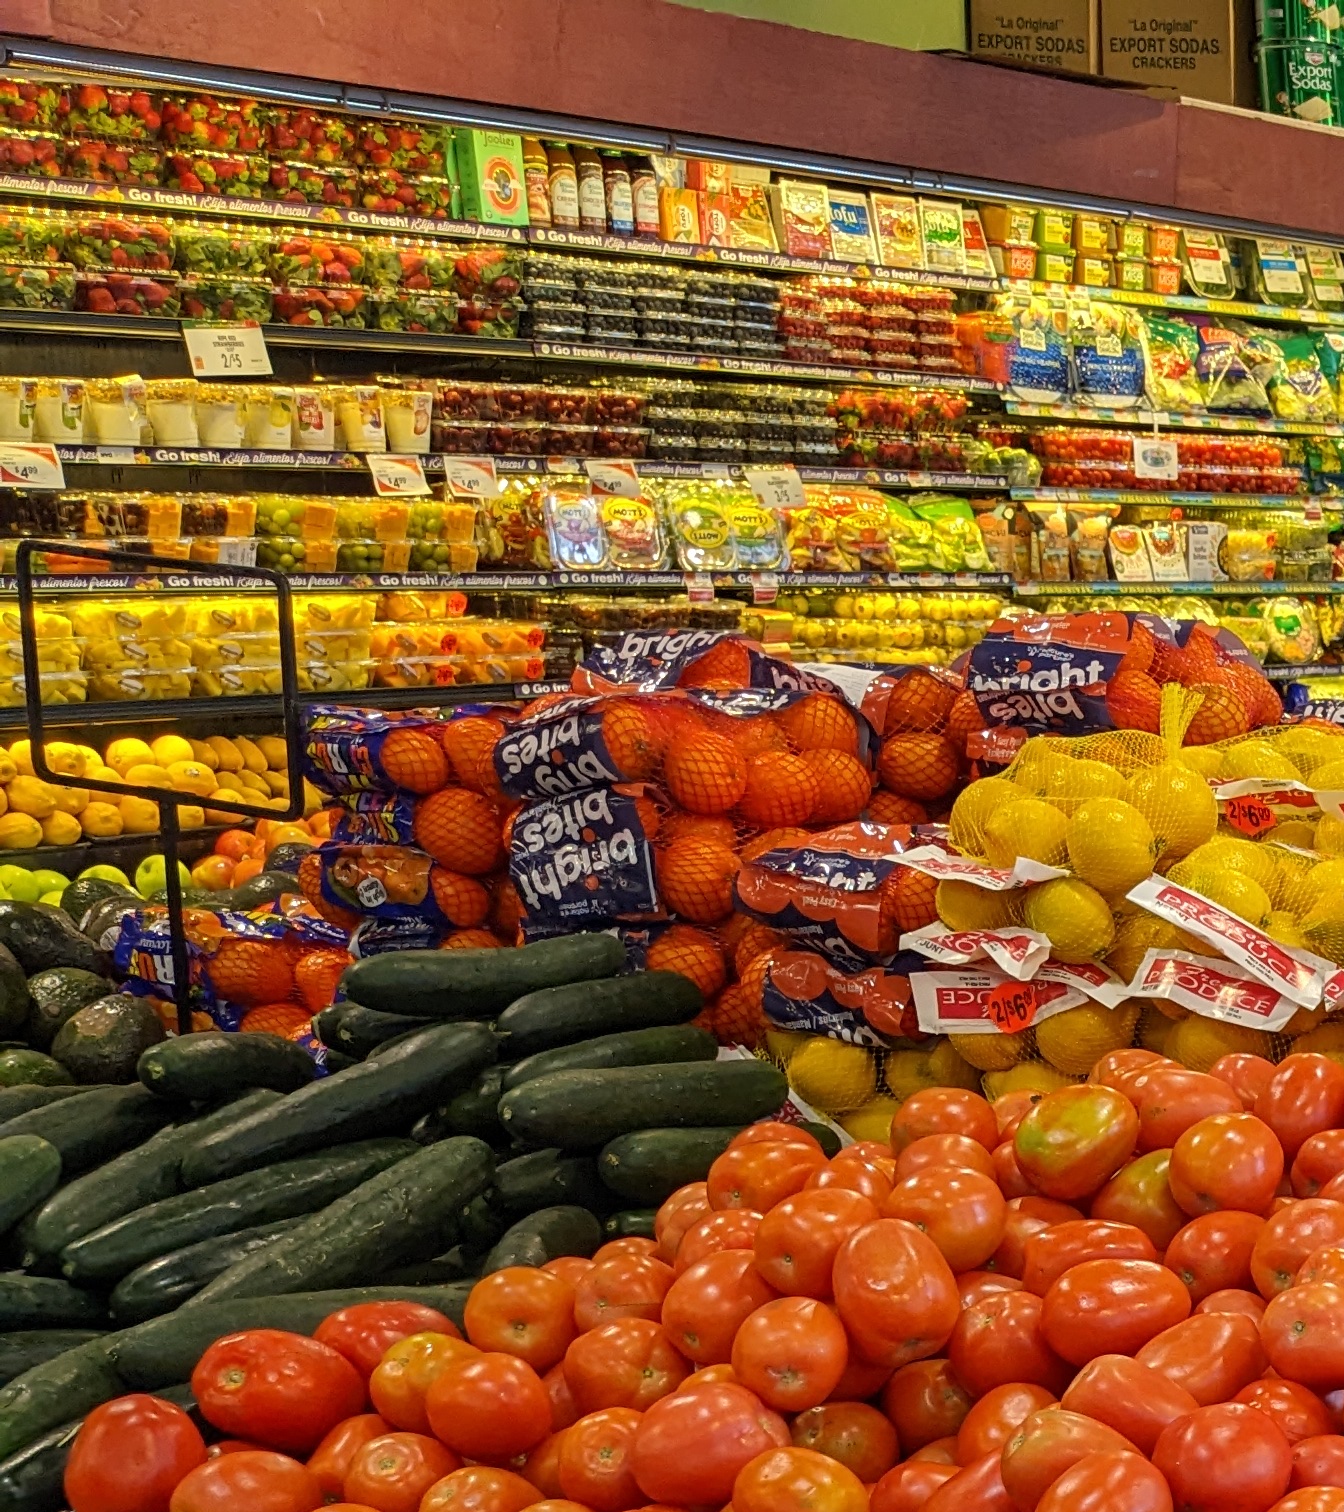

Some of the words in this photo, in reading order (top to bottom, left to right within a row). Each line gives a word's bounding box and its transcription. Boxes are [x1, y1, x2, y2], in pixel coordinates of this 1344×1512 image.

[978, 34, 1031, 50] EXPORT
[1036, 36, 1084, 53] SODAS
[1110, 38, 1164, 53] EXPORT
[1169, 39, 1219, 54] SODAS
[1132, 57, 1196, 70] CRACKERS
[1289, 62, 1332, 80] Export
[1292, 76, 1332, 92] Sodas
[128, 188, 151, 203] Go
[155, 191, 197, 206] fresh!
[348, 211, 370, 225] Go
[373, 213, 408, 227] fresh!
[523, 789, 613, 853] bites
[518, 828, 637, 908] bright
